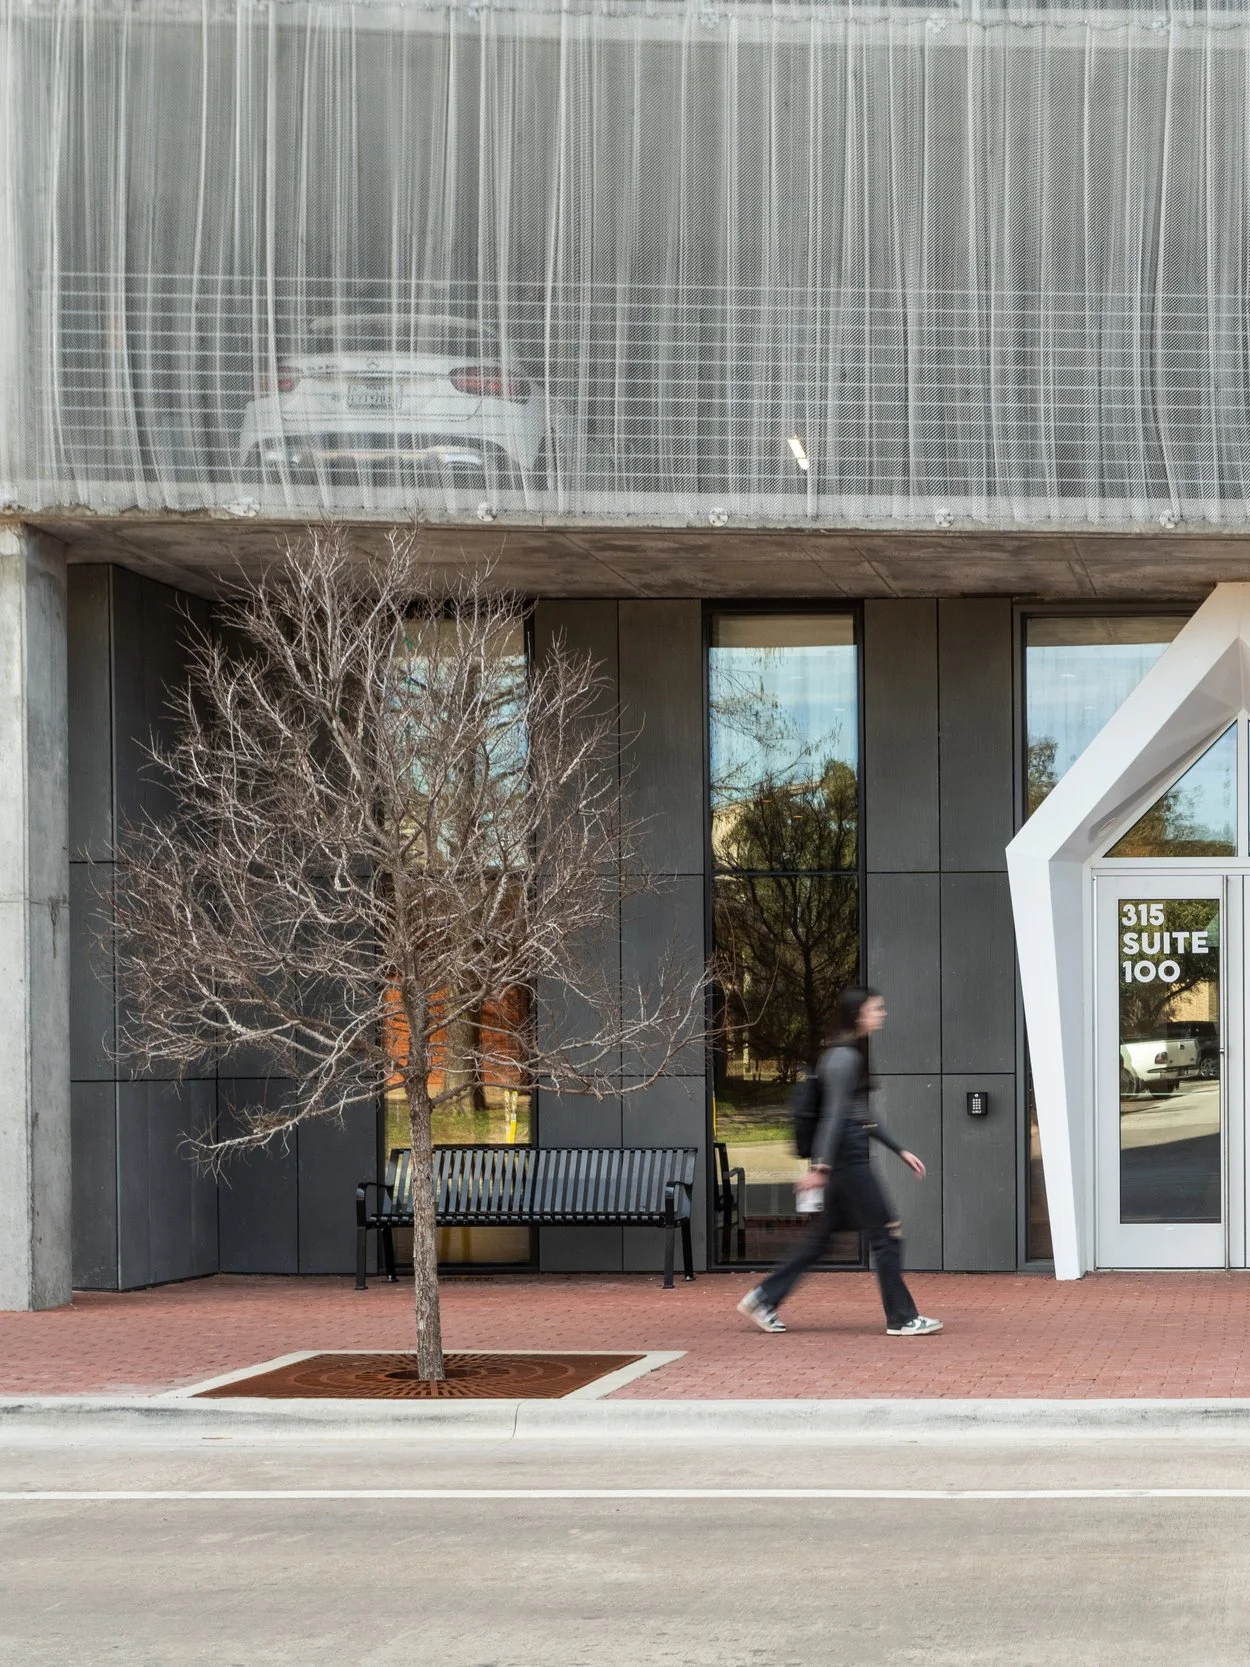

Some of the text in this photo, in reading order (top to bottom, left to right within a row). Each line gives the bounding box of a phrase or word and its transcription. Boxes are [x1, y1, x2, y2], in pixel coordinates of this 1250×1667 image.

[1122, 904, 1165, 926] 315
[1123, 932, 1209, 955] SUITE
[1123, 960, 1180, 983] 100
